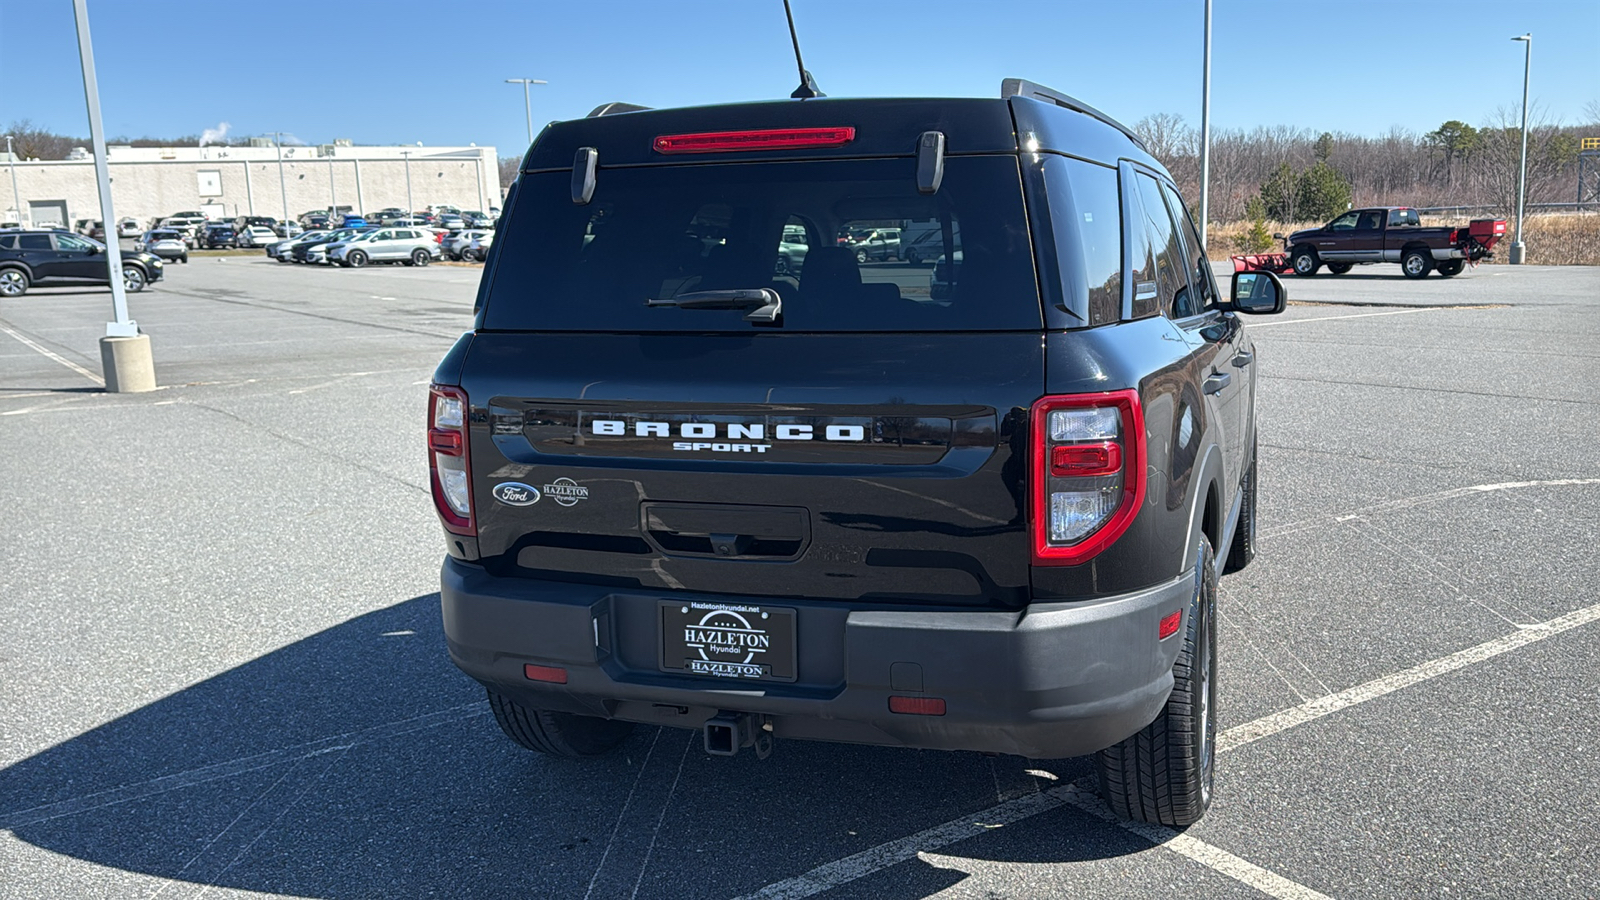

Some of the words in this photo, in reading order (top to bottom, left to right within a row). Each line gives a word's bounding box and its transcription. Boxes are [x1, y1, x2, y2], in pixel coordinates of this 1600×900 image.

[592, 420, 864, 441] BRONCO
[673, 442, 772, 453] SPORT
[502, 486, 528, 501] Ford
[543, 485, 589, 497] HAZLETON
[691, 601, 760, 613] HazletonHyundai.net
[684, 629, 769, 648] HAZLETON
[710, 644, 741, 654] Hyundai
[691, 662, 763, 675] HAZLETON
